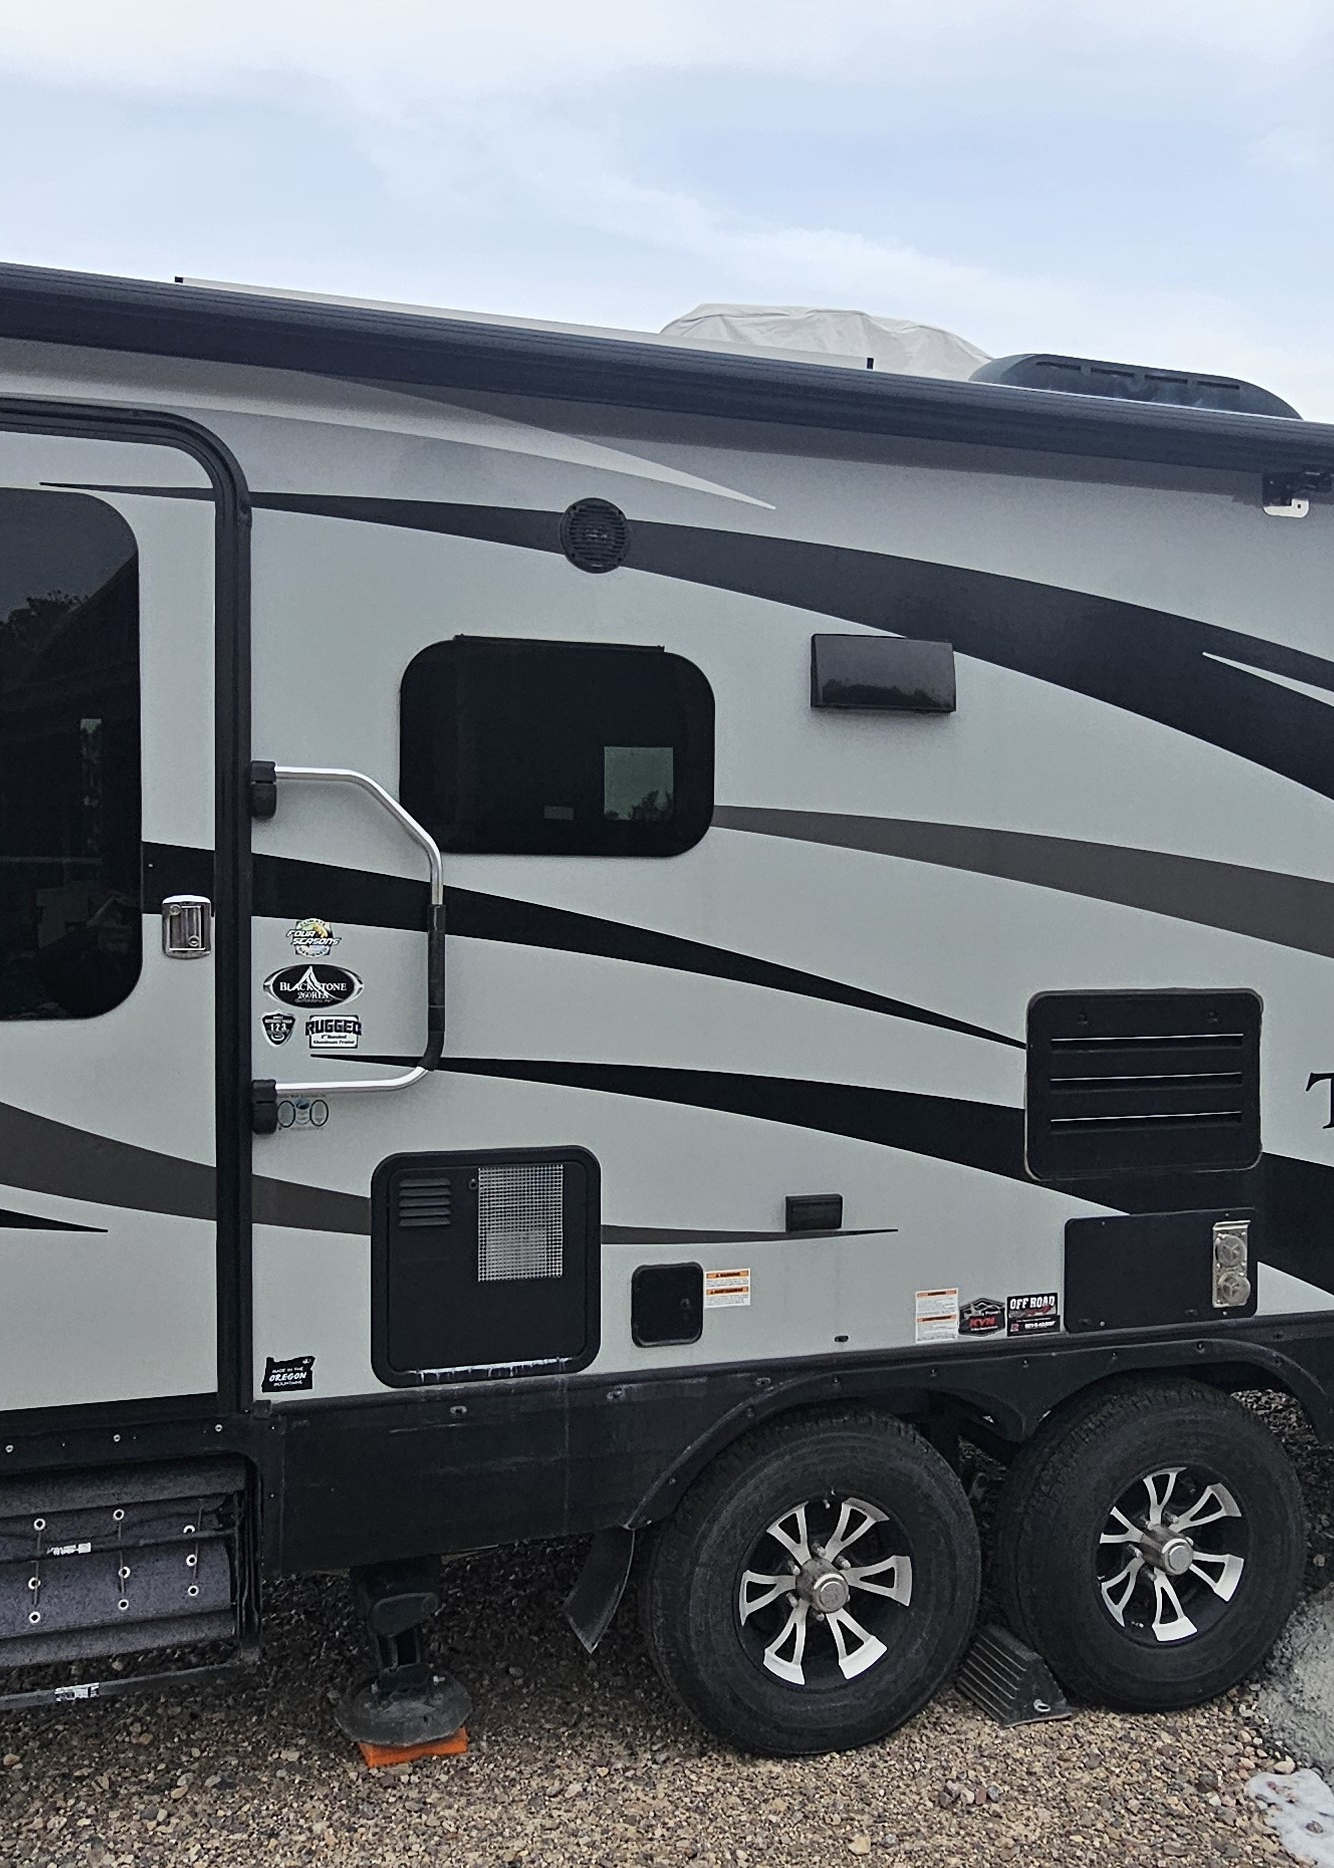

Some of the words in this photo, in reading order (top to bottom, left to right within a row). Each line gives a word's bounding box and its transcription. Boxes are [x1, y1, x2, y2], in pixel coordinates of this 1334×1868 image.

[292, 937, 340, 945] SEASONS
[305, 1019, 362, 1036] RUGGED
[1010, 1297, 1029, 1310] OFF
[1029, 1295, 1056, 1309] ROAD
[269, 1372, 307, 1382] OREGON
